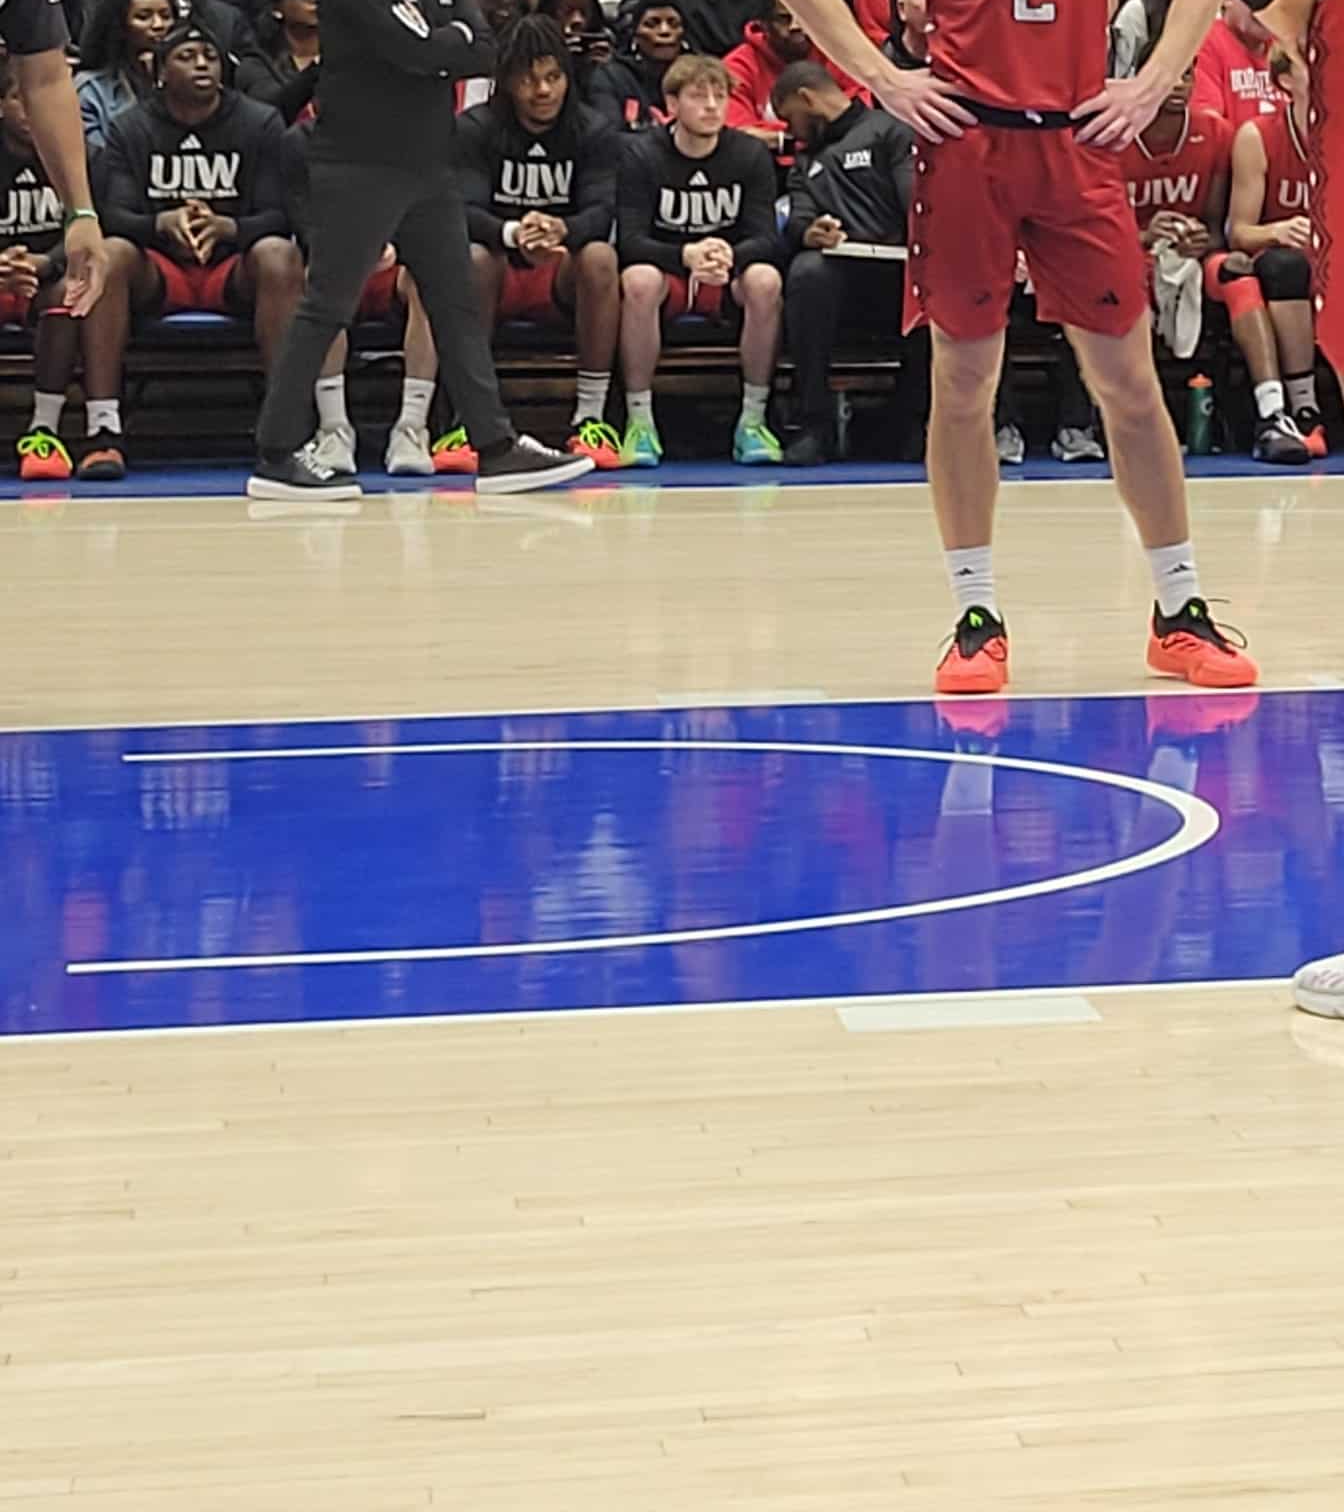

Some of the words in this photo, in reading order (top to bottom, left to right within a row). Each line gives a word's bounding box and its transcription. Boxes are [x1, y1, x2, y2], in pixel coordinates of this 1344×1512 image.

[151, 151, 240, 190] UIW
[501, 159, 573, 198] UIW
[1128, 172, 1200, 208] UIW
[659, 184, 741, 226] UIW
[1279, 176, 1311, 210] UI
